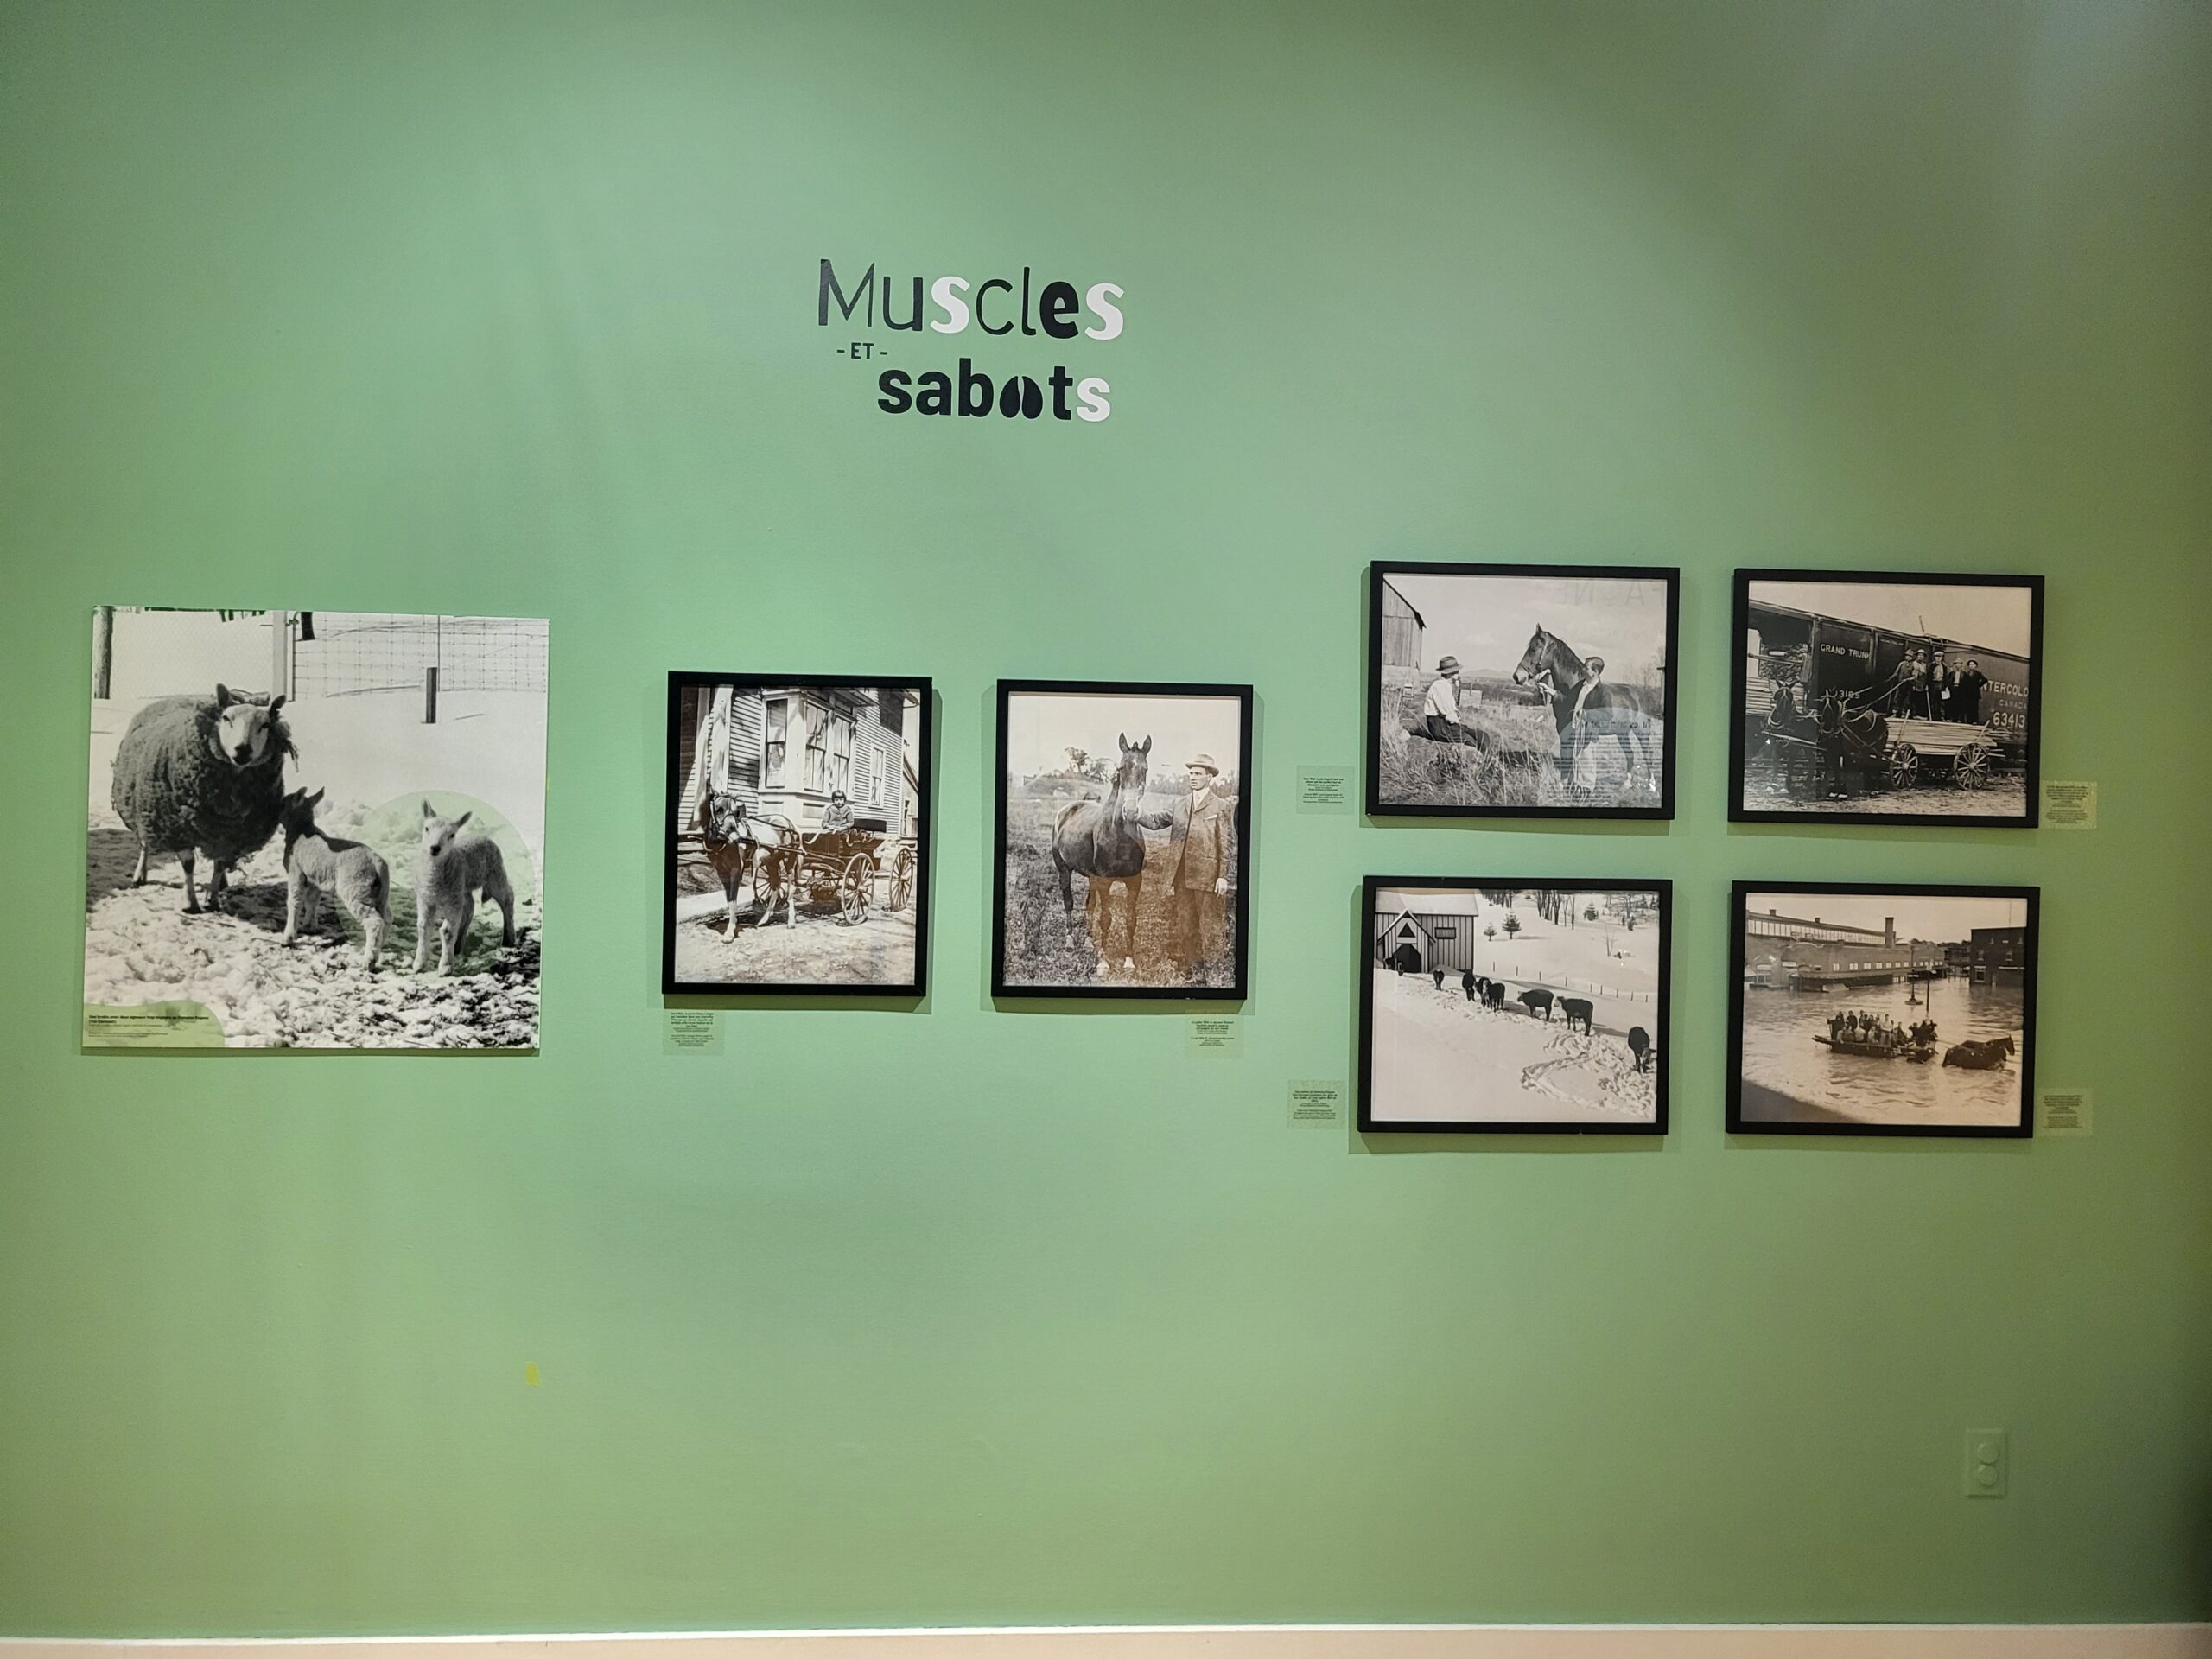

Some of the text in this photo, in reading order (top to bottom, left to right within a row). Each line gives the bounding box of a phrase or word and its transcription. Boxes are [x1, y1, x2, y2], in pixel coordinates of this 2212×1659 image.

[818, 258, 1124, 340] Muscles
[877, 358, 1111, 423] sabots
[1820, 644, 1846, 655] GRAND
[1999, 698, 2027, 709] CANADA
[1993, 711, 2025, 728] 63413
